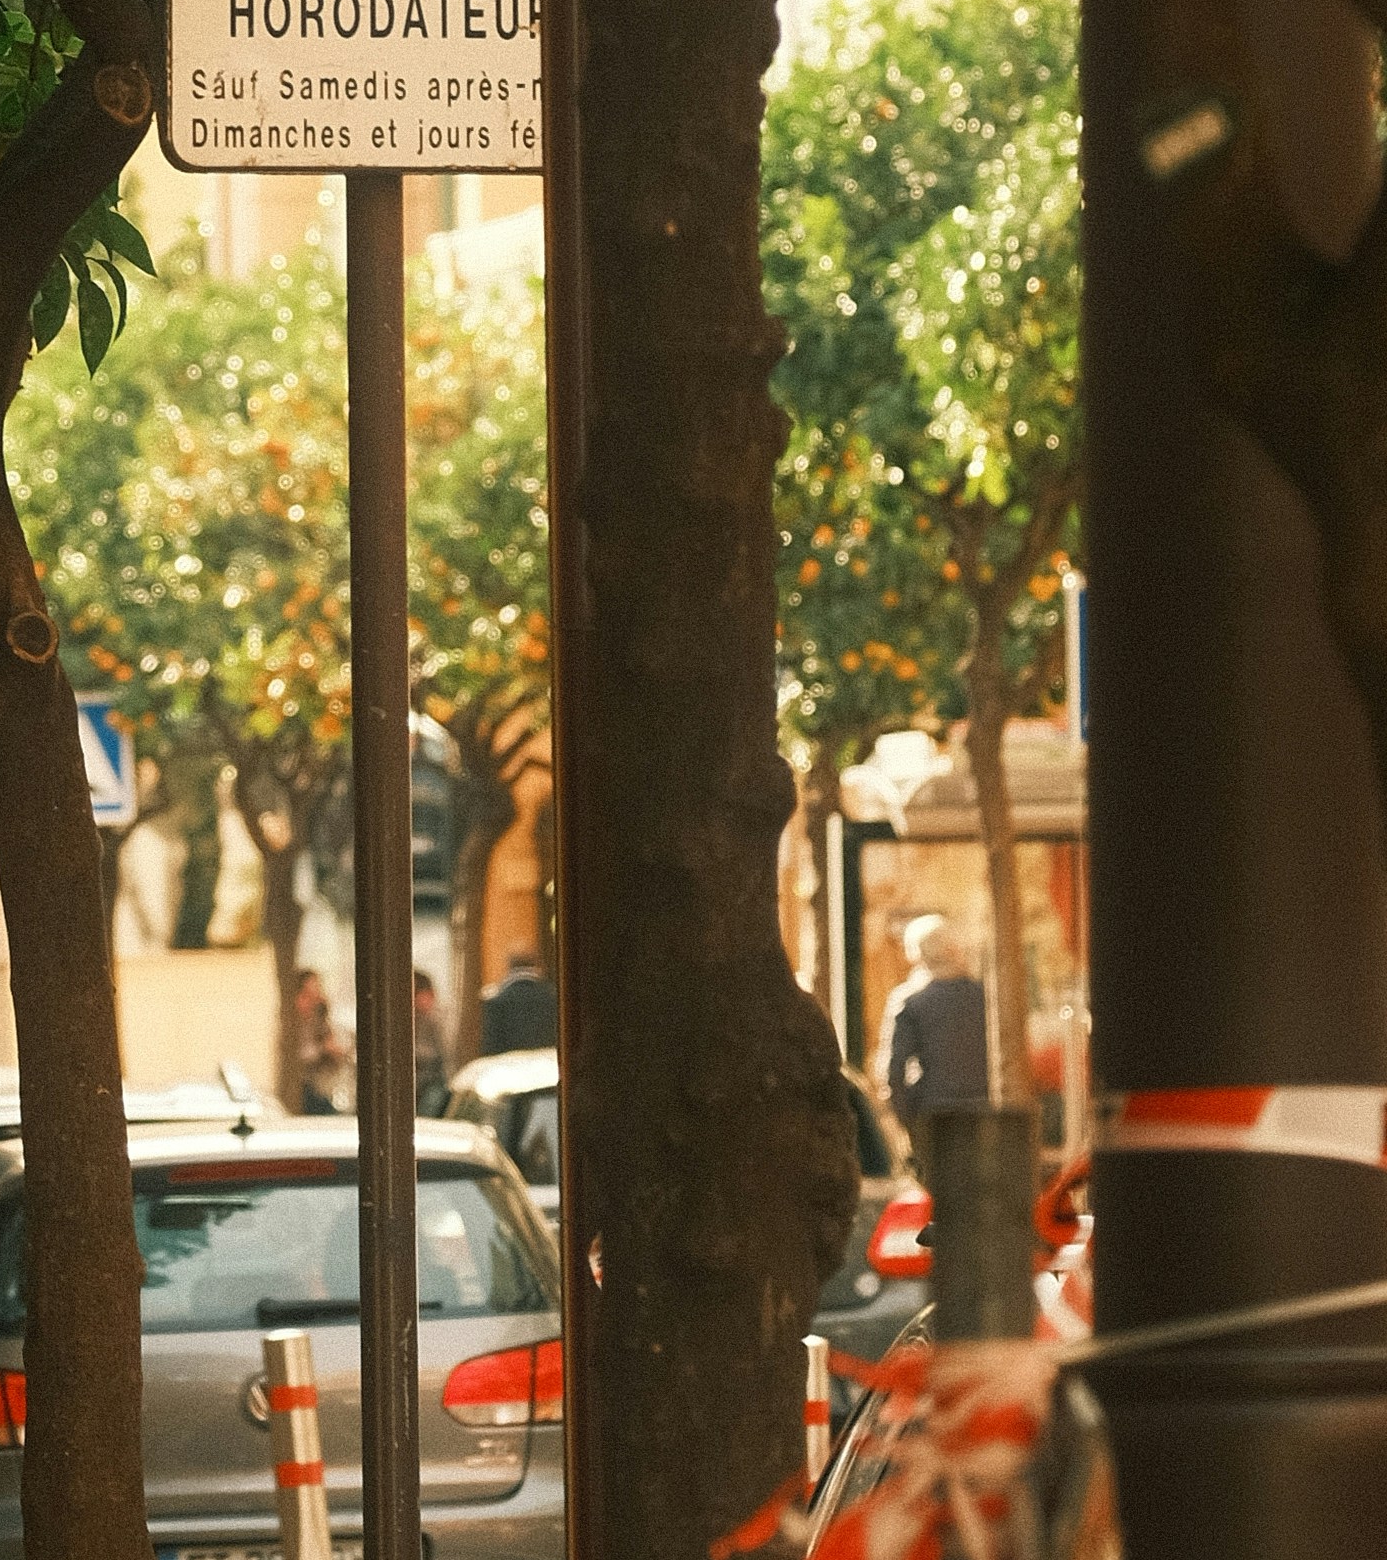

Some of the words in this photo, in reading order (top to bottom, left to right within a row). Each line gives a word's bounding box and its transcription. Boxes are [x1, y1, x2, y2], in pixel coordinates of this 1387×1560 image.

[279, 69, 408, 101] Samedis
[191, 118, 351, 149] Dimanches
[371, 120, 398, 149] et
[416, 118, 490, 155] jours
